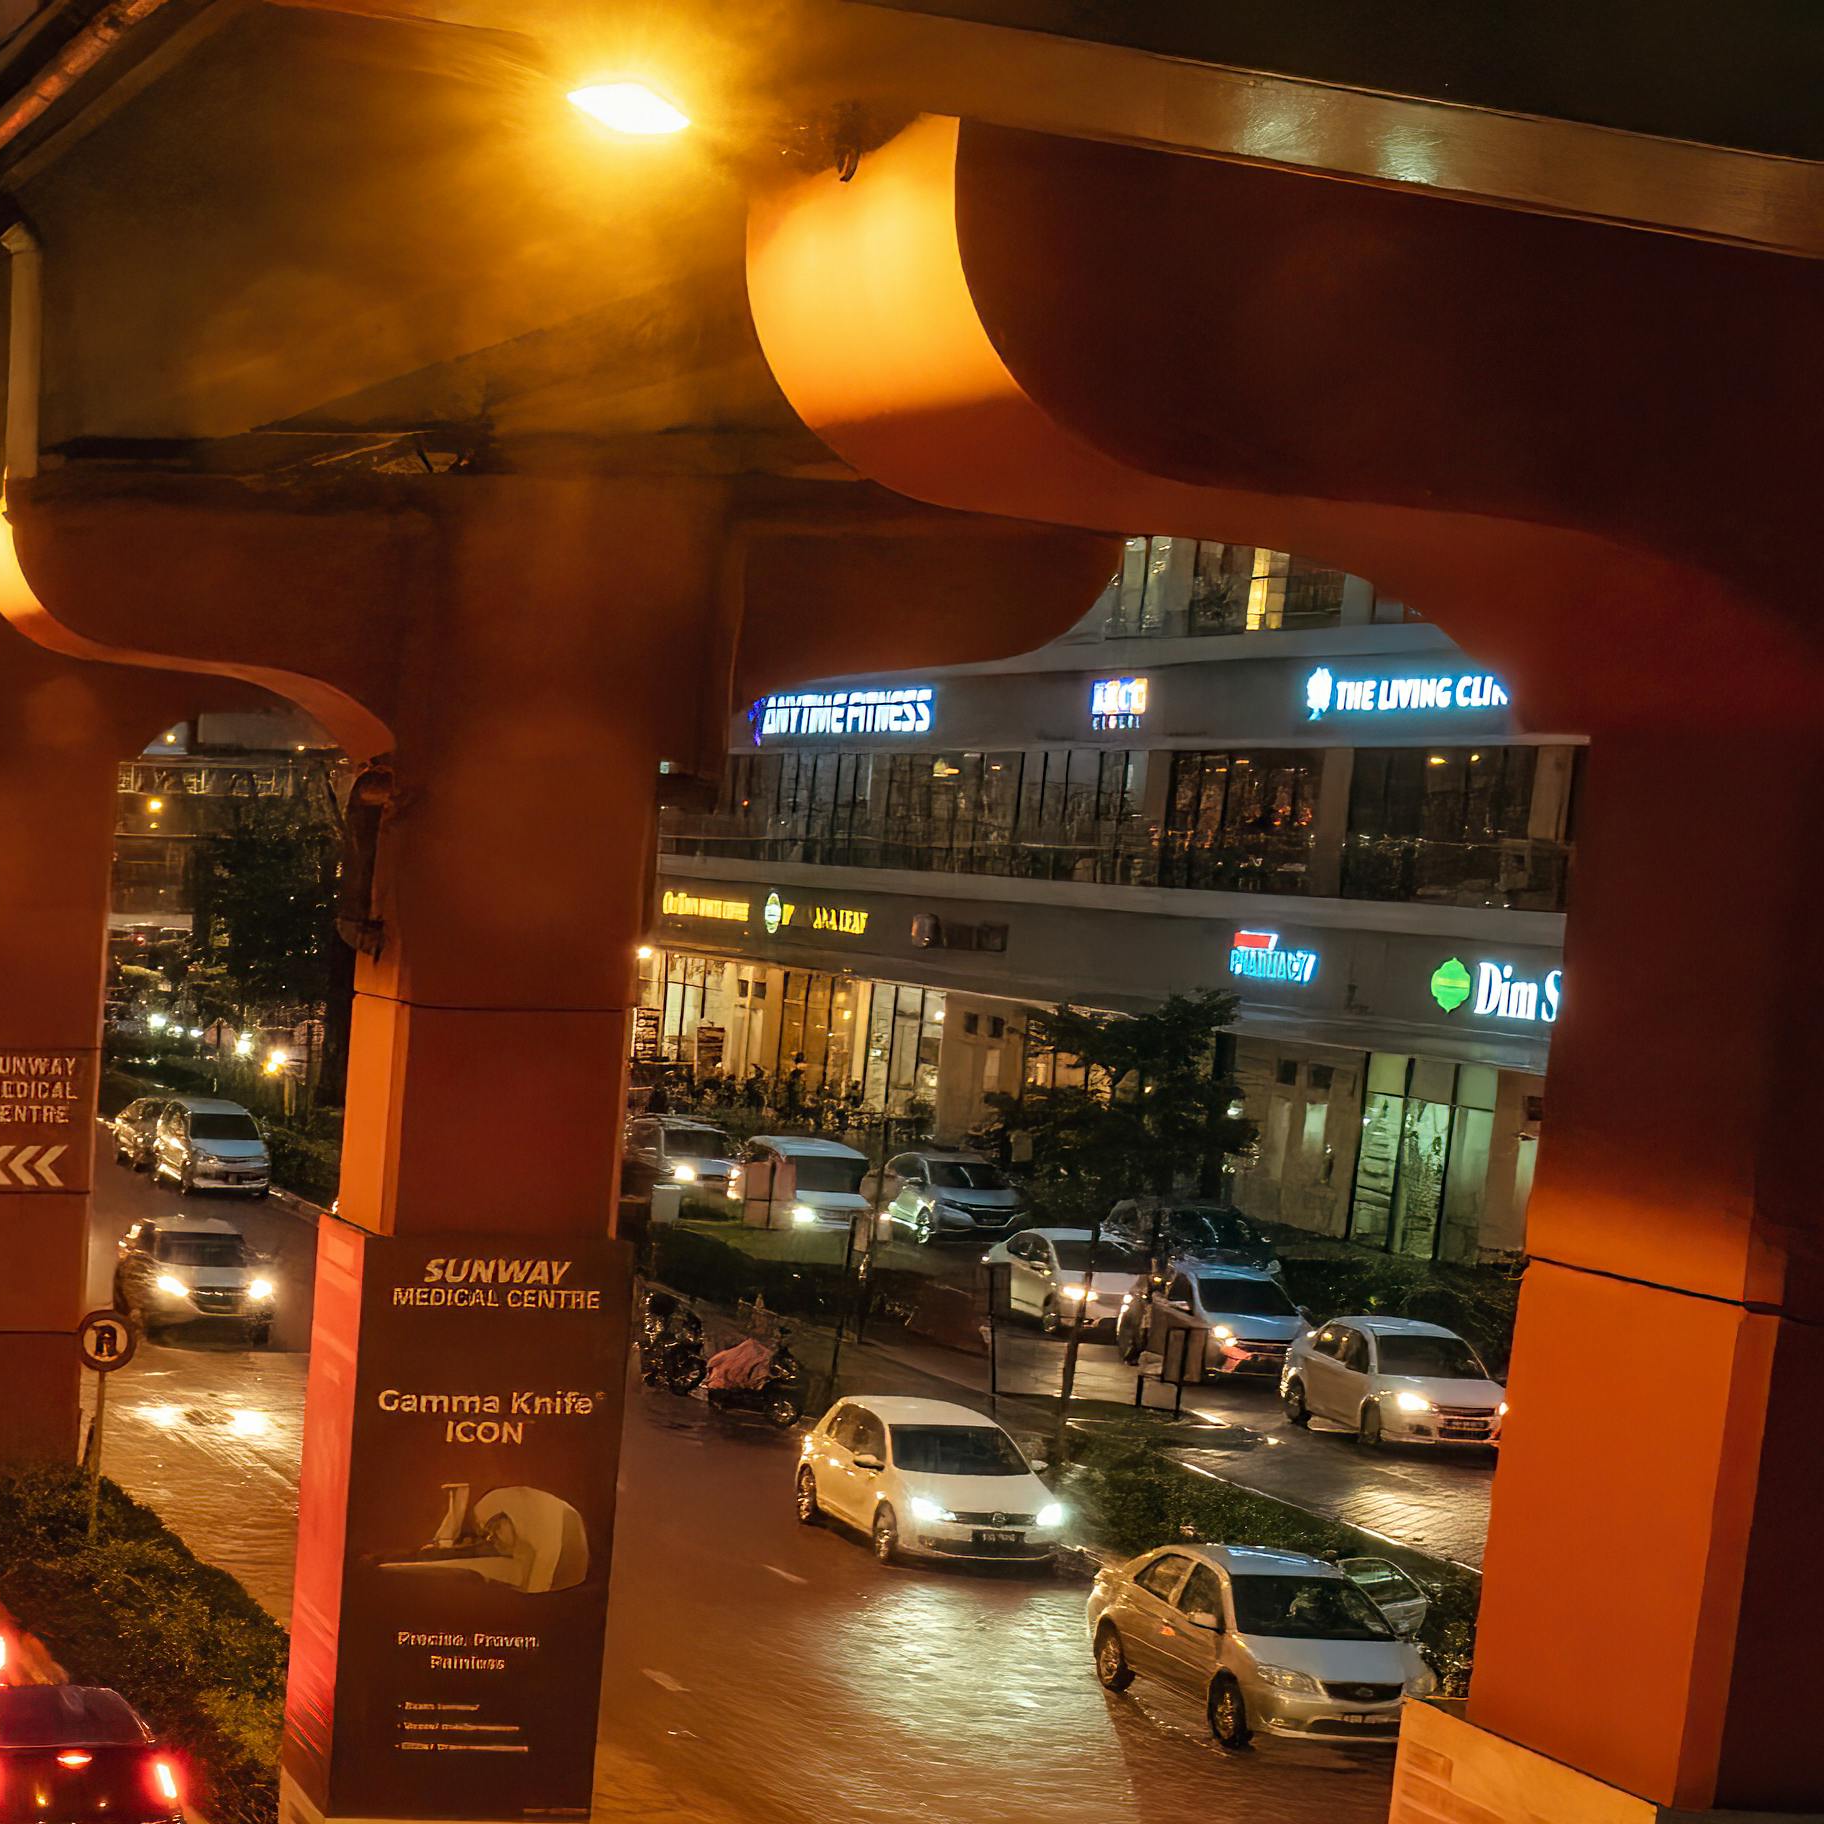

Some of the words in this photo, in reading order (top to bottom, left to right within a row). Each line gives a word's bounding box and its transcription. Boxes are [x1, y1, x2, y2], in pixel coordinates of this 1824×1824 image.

[1336, 680, 1376, 710] THE
[1378, 678, 1451, 710] LIVING
[763, 691, 848, 735] ANYTIME
[1474, 961, 1539, 1021] Dim
[424, 1258, 572, 1285] SUNWAY
[393, 1287, 499, 1307] MEDICAL
[507, 1289, 601, 1310] CENTRE
[378, 1389, 500, 1414] Gamma
[446, 1420, 523, 1444] ICON
